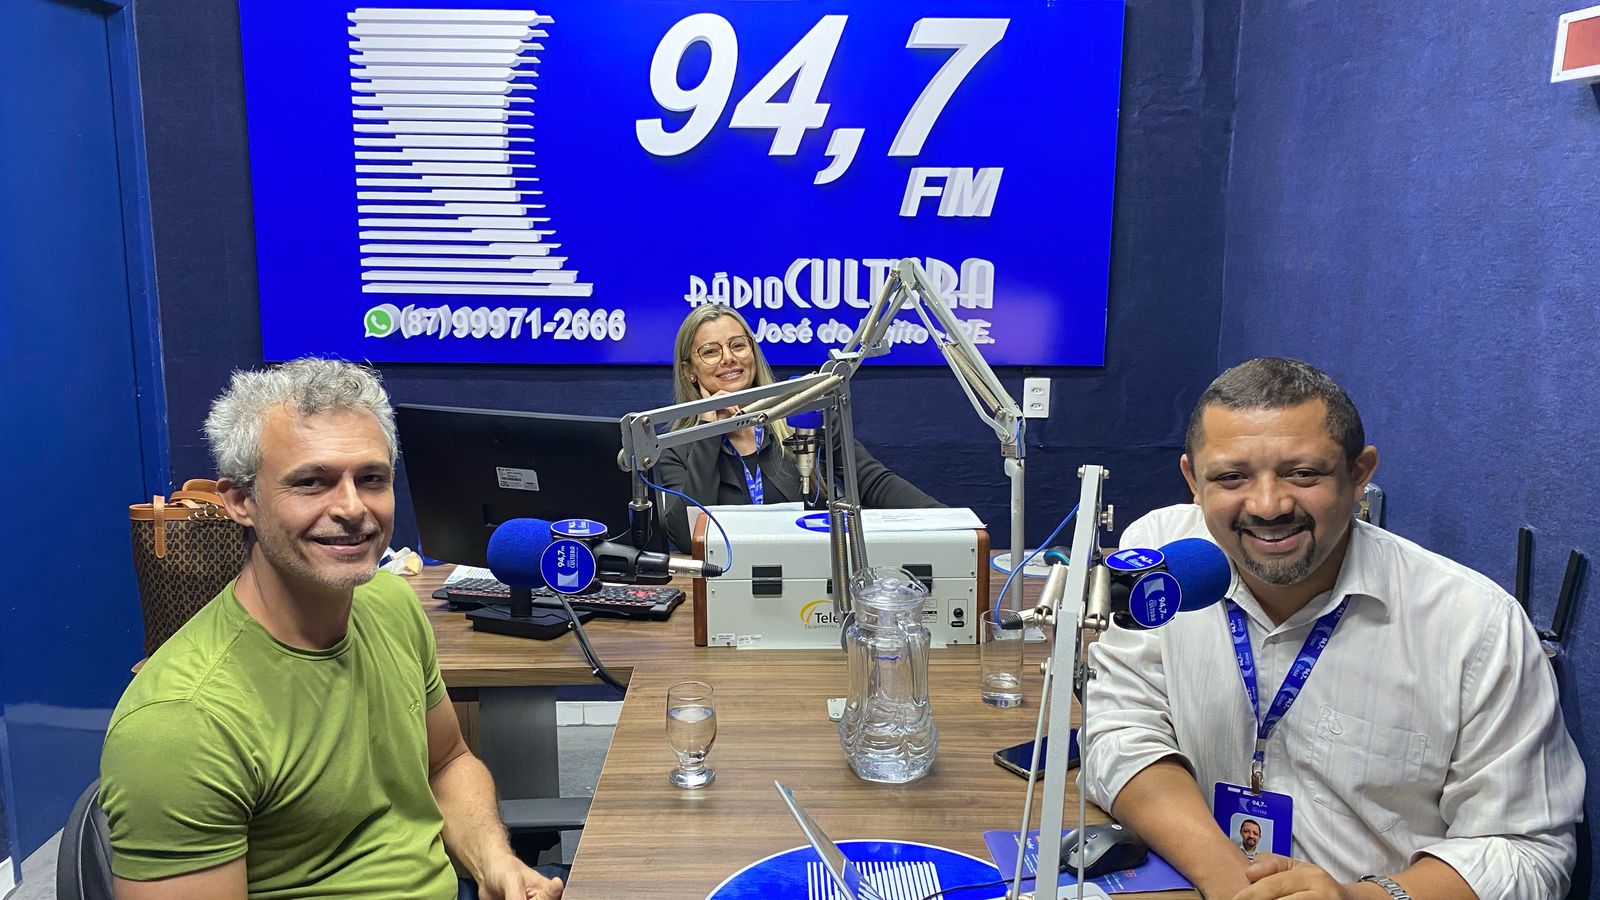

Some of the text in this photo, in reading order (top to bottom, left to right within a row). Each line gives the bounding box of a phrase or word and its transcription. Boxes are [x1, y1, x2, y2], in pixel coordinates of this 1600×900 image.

[635, 12, 1011, 185] 94,7
[899, 167, 1004, 217] FM
[400, 303, 627, 341] (87)99971-2666
[754, 317, 813, 344] José
[817, 319, 854, 344] do
[858, 318, 929, 349] gito
